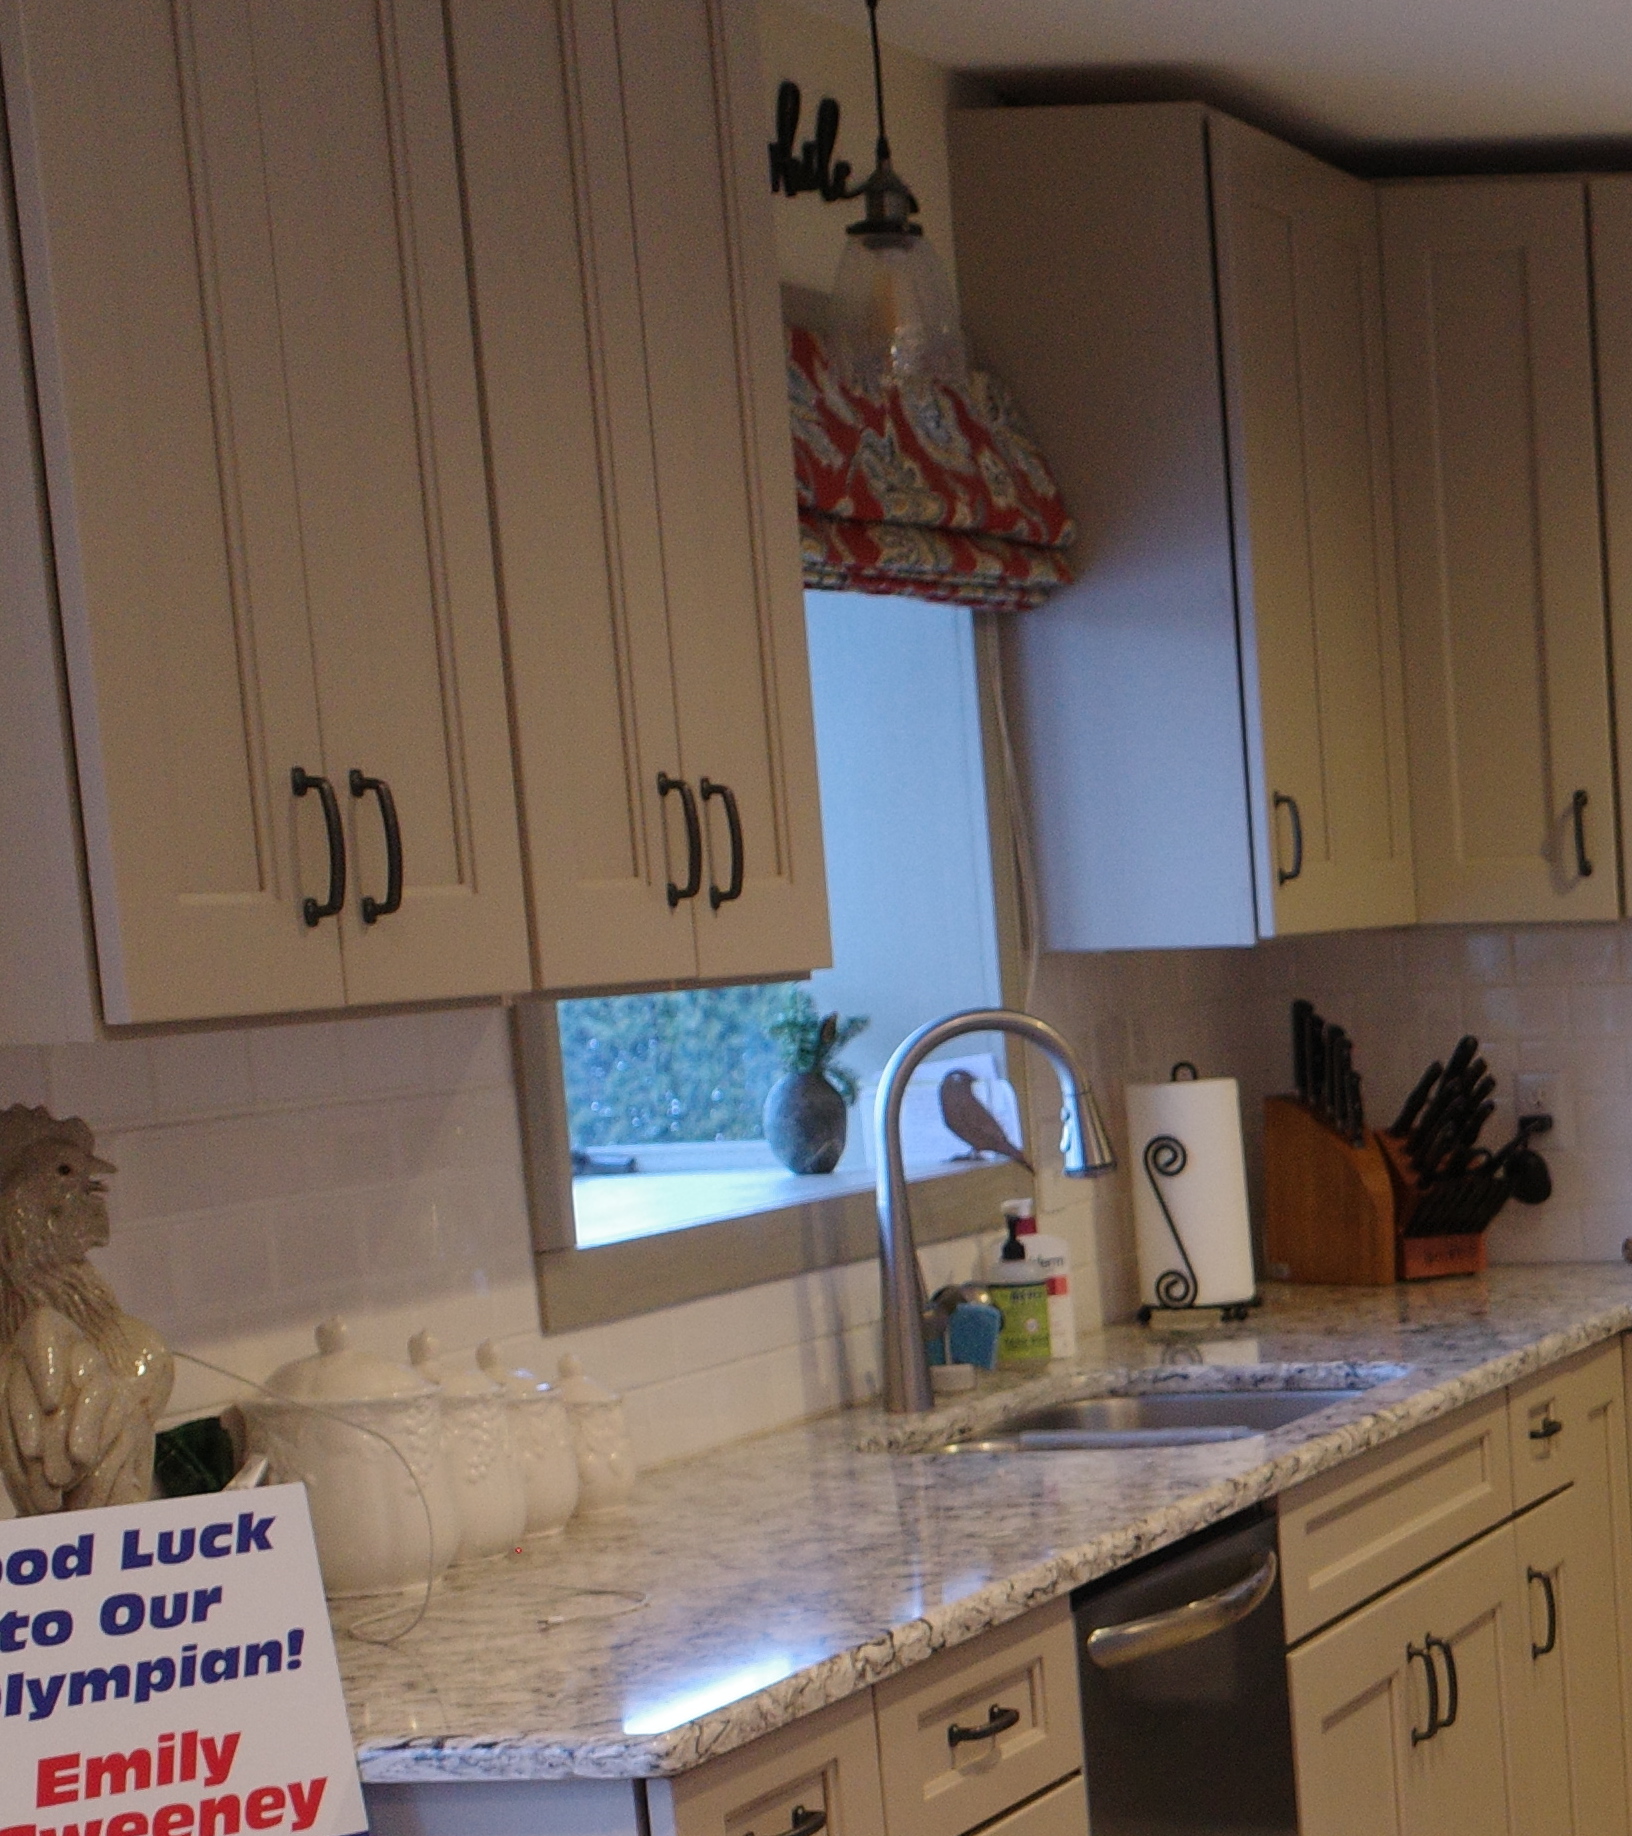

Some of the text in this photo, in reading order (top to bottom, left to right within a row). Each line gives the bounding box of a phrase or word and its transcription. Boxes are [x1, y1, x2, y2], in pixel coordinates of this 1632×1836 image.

[0, 1511, 275, 1587] od Luck
[0, 1586, 223, 1654] to Our
[0, 1630, 305, 1721] lympian!
[35, 1730, 241, 1808] Emily
